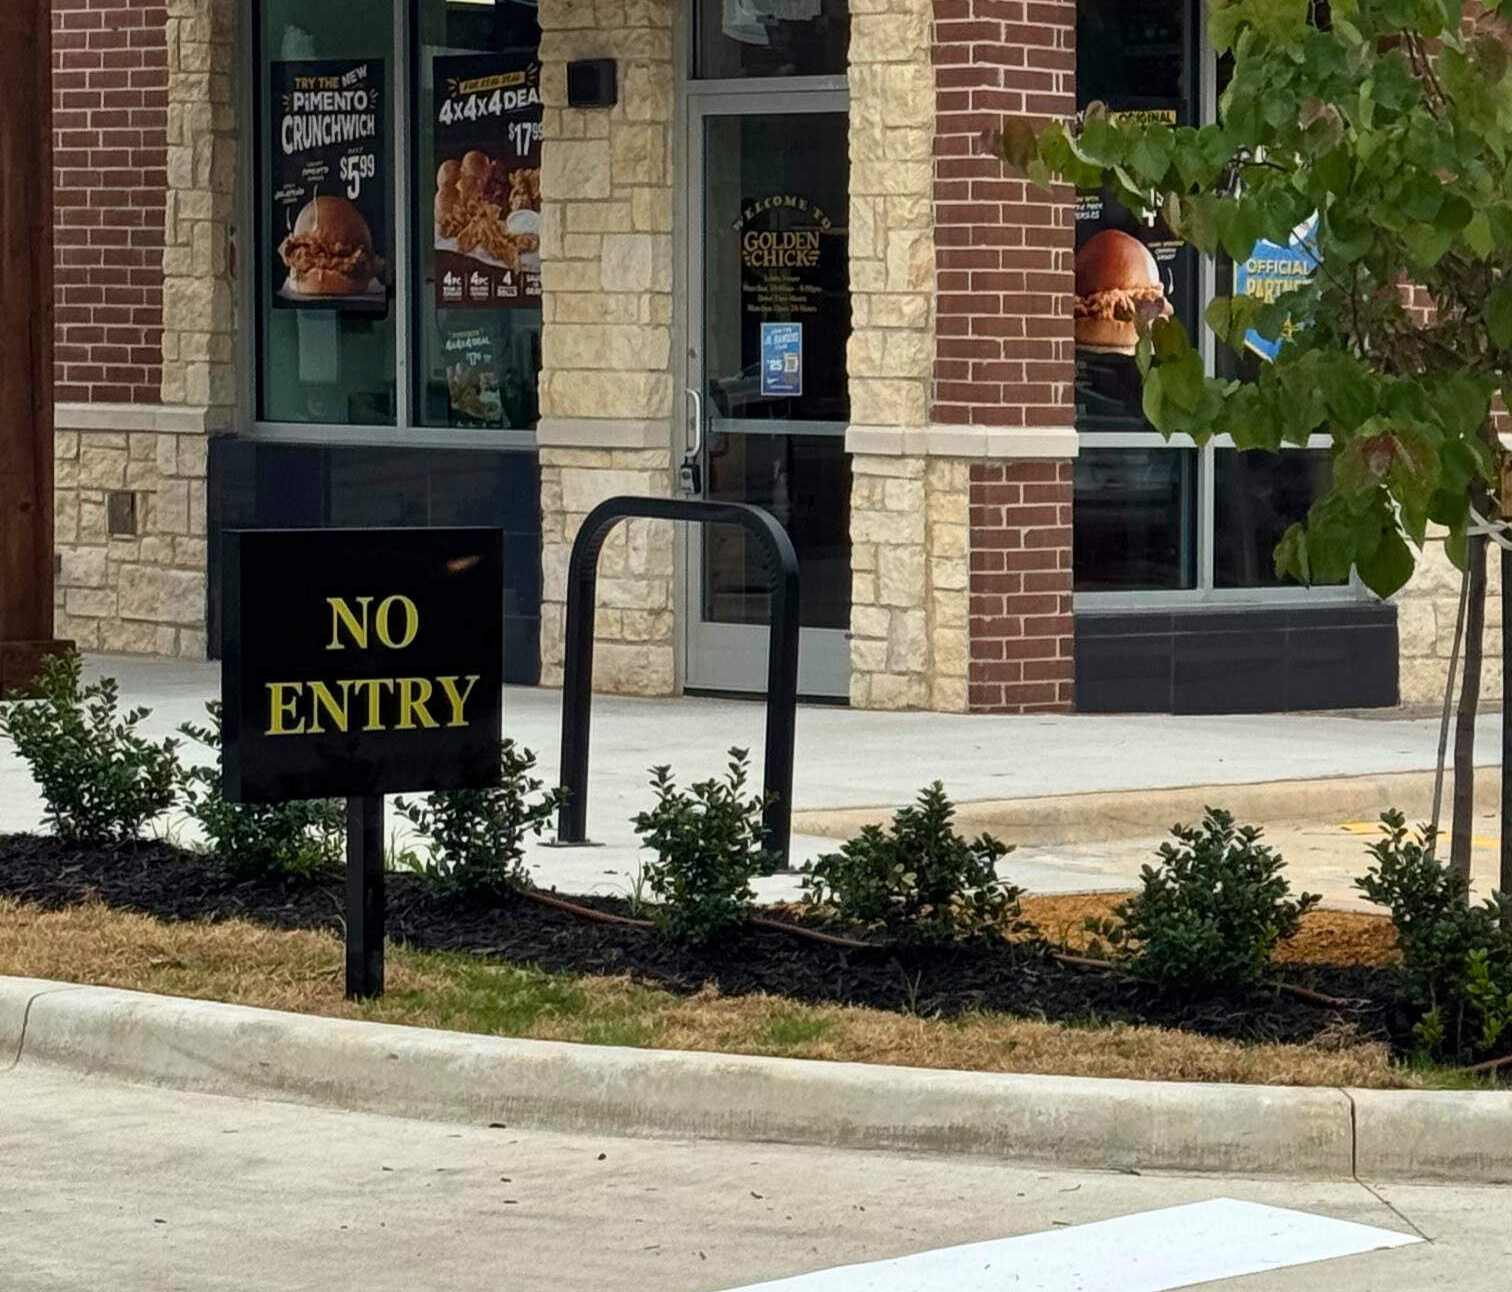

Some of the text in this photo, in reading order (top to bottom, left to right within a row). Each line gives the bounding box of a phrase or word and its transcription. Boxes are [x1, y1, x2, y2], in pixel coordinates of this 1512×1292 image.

[295, 64, 367, 89] TRY THE NEW
[503, 87, 540, 110] DEA
[281, 114, 375, 154] CRUNCHWICH
[733, 195, 832, 231] WELCOME TO
[743, 230, 820, 251] GOLDEN
[751, 249, 810, 267] CHICK
[1246, 259, 1312, 276] OFFICIAL
[326, 595, 419, 650] NO
[264, 675, 480, 735] ENTRY
